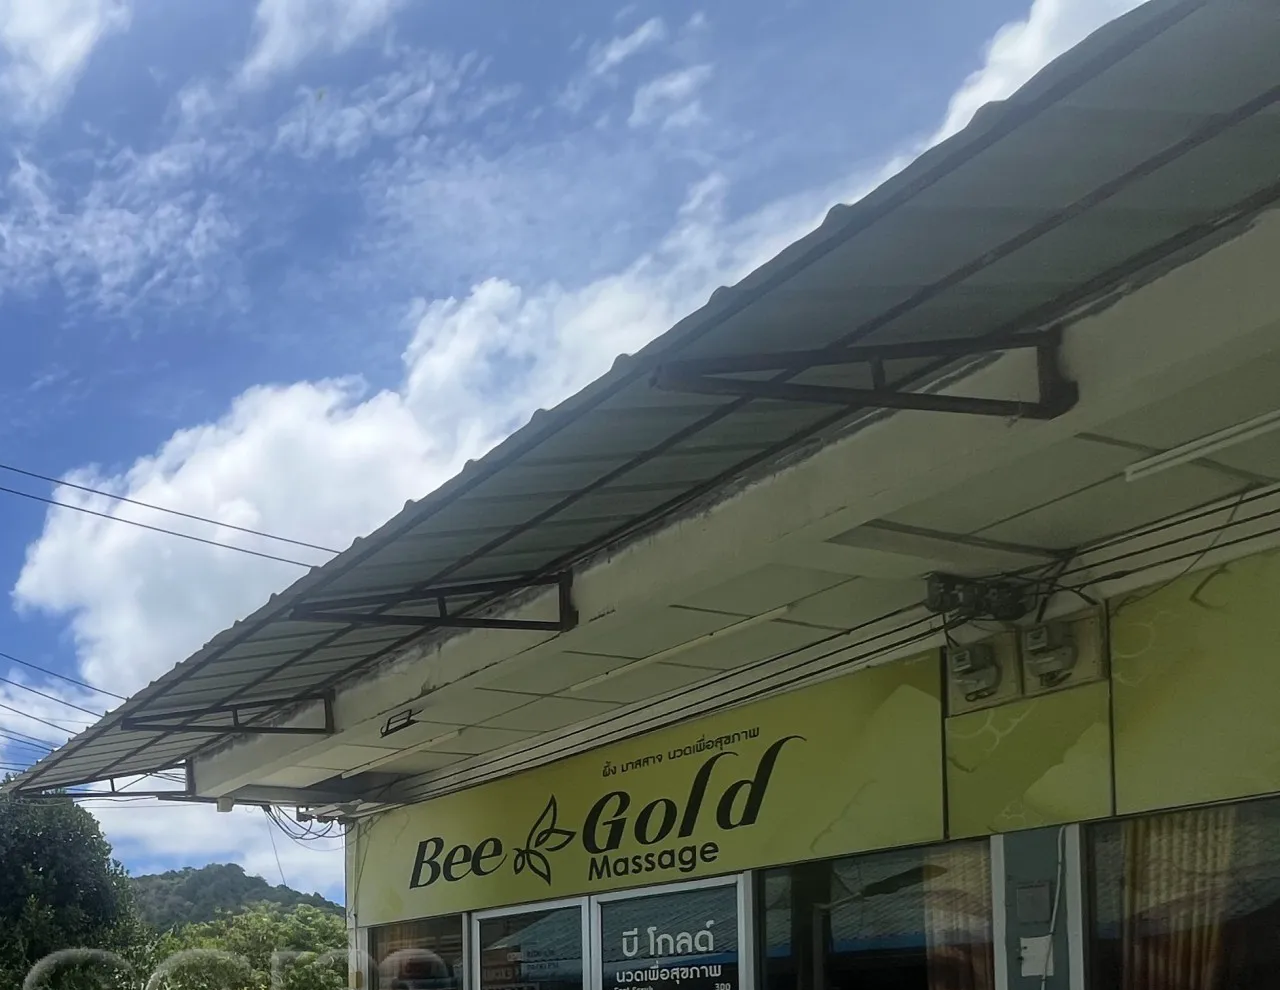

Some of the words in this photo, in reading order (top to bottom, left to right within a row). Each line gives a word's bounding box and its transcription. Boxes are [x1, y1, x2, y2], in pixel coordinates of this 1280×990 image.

[667, 727, 760, 760] นวดเพื่อสุขภาพ
[409, 836, 508, 890] Bee
[581, 735, 807, 854] Gold
[587, 841, 719, 881] Massage
[622, 927, 638, 957] บี
[646, 919, 715, 956] โกลด์
[616, 960, 722, 985] นวดเพื่อสุขภาพ
